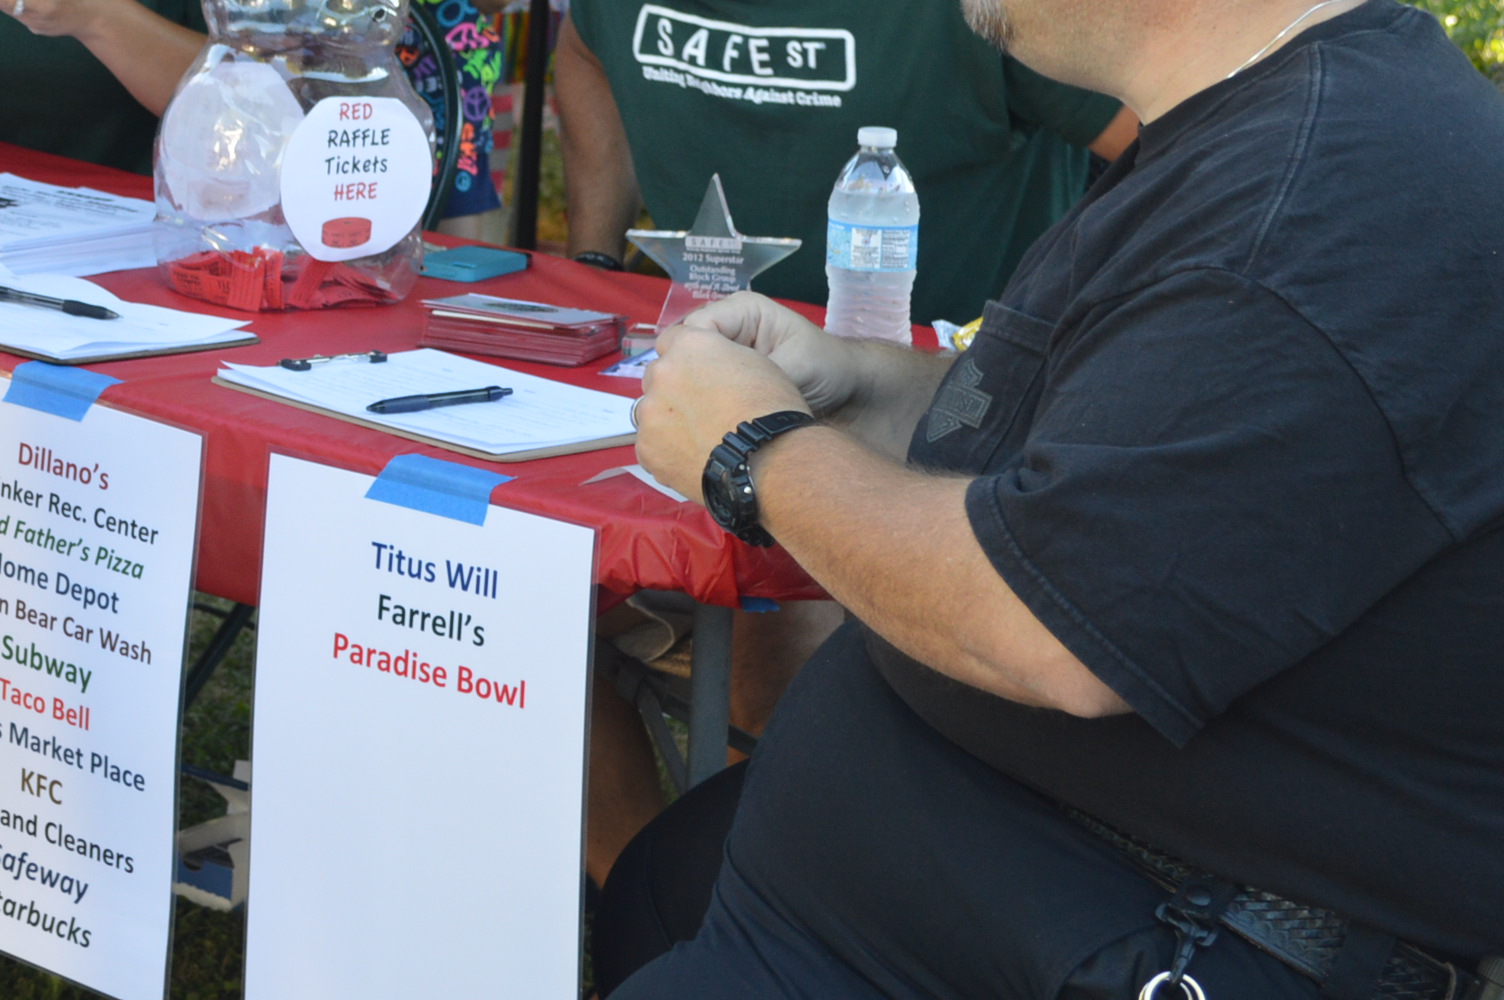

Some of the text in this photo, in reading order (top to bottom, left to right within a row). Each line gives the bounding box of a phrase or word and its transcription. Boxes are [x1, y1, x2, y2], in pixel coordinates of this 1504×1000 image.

[657, 17, 774, 76] SAFE
[339, 102, 373, 121] RED
[795, 91, 842, 108] Crime
[327, 128, 391, 148] RAFFLE
[325, 155, 388, 175] Tickets
[334, 182, 378, 201] HERE
[682, 252, 745, 265] 2012 Superstar
[18, 442, 109, 490] Dillano's
[47, 492, 87, 524] Rec.
[93, 507, 159, 545] Center
[13, 520, 90, 562] Father's
[94, 546, 145, 580] Pizza
[371, 541, 498, 599] Titus Will
[55, 571, 119, 614] Depot
[15, 599, 57, 632] Bear
[62, 616, 94, 644] Car
[98, 626, 152, 665] Wash
[377, 593, 485, 647] Farrell's
[0, 635, 92, 694] Subway
[333, 632, 526, 709] Paradise Bowl
[52, 697, 90, 731] Bell
[9, 722, 84, 770] Market
[90, 752, 146, 792] Place
[20, 767, 63, 805] KFC
[44, 821, 135, 874] Cleaners
